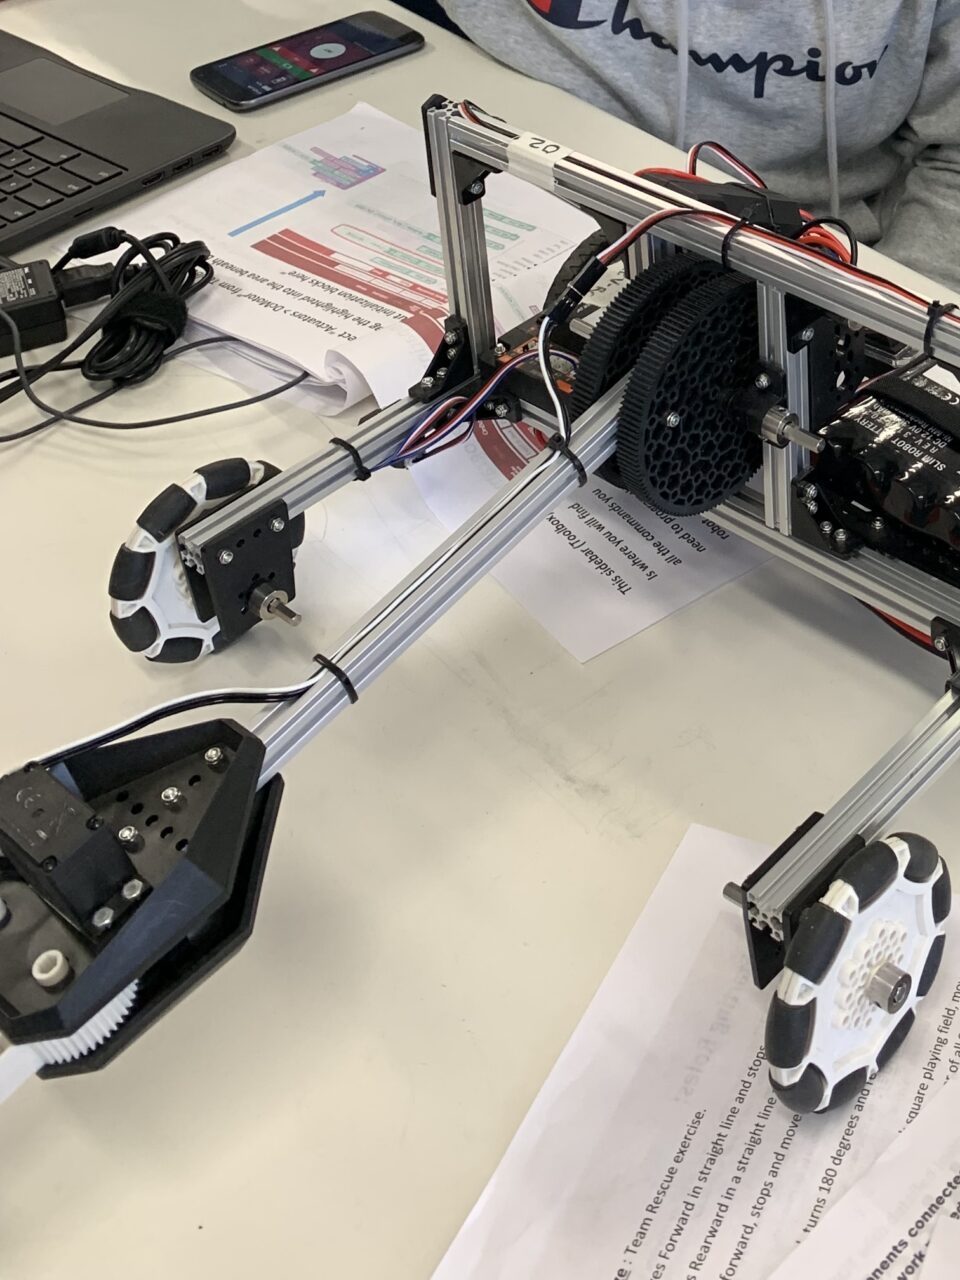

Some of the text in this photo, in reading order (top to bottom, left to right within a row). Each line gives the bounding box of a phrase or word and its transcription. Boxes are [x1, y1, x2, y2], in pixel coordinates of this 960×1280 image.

[853, 412, 947, 471] SLIM ROBOT TTERY
[567, 502, 591, 520] find
[584, 516, 606, 533] will
[592, 488, 683, 566] all the commands you
[602, 530, 625, 548] you
[670, 523, 684, 535] to
[678, 532, 707, 553] need
[580, 547, 615, 577] sidebar
[618, 545, 649, 572] where
[610, 575, 632, 596] This
[922, 1036, 949, 1081] playing
[936, 1006, 959, 1034] field,
[948, 1058, 960, 1074] of
[818, 1167, 838, 1194] 180
[830, 1107, 860, 1166] degrees
[855, 1093, 872, 1112] and
[623, 1217, 654, 1254] Team
[645, 1166, 678, 1214] Rescue
[673, 1109, 707, 1164] exercise.
[657, 1200, 696, 1260] Forward
[687, 1185, 704, 1199] in
[697, 1132, 729, 1183] straight
[719, 1106, 740, 1130] line
[734, 1079, 753, 1104] and
[688, 1096, 777, 1272] Rearward in a straight line
[750, 1180, 774, 1218] stops
[768, 1151, 786, 1178] and
